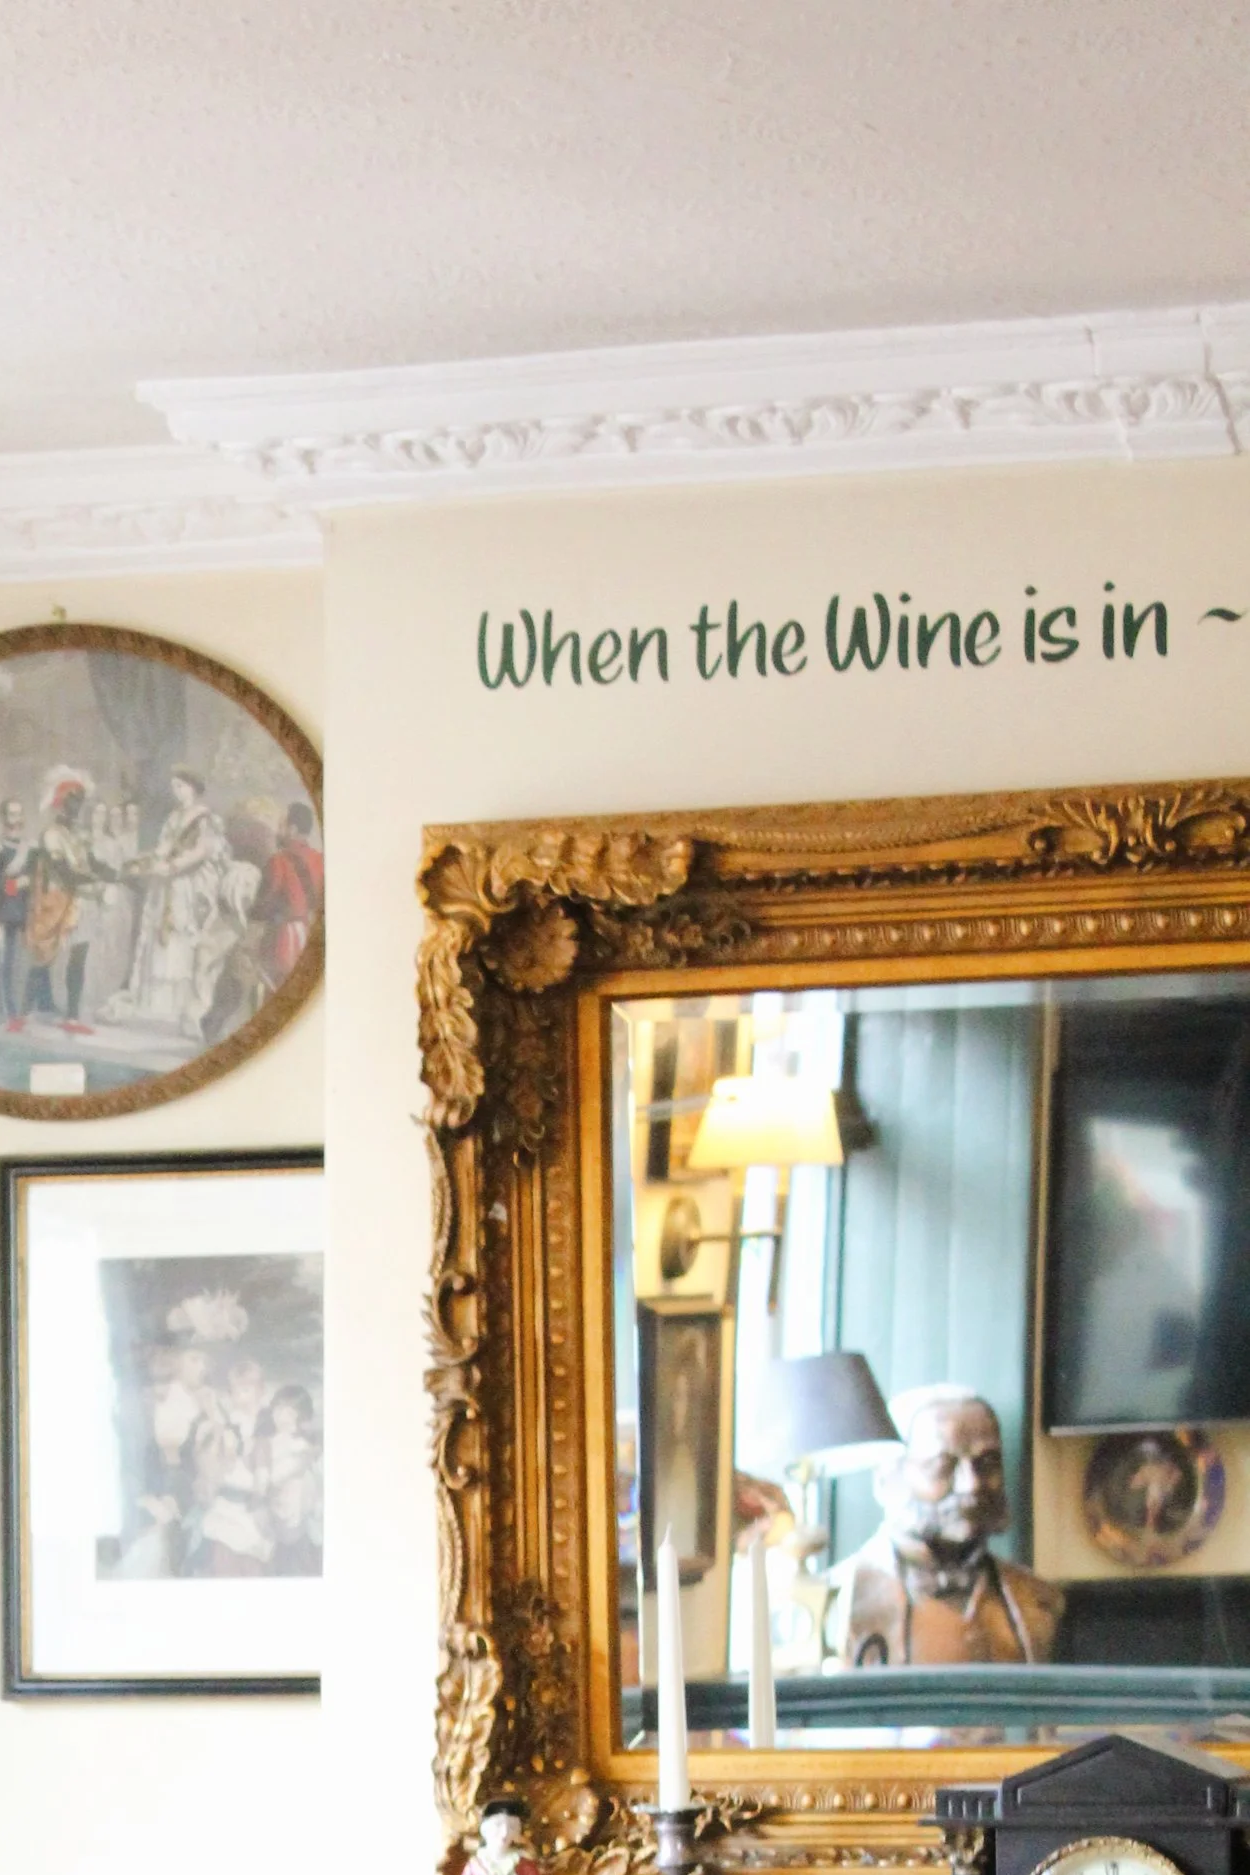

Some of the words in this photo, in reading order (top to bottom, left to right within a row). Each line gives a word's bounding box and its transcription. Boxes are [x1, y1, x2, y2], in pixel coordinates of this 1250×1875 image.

[476, 608, 670, 691] When
[689, 598, 809, 681] the
[824, 591, 1003, 673] Wine
[1023, 584, 1080, 664] is
[1102, 580, 1168, 661] in
